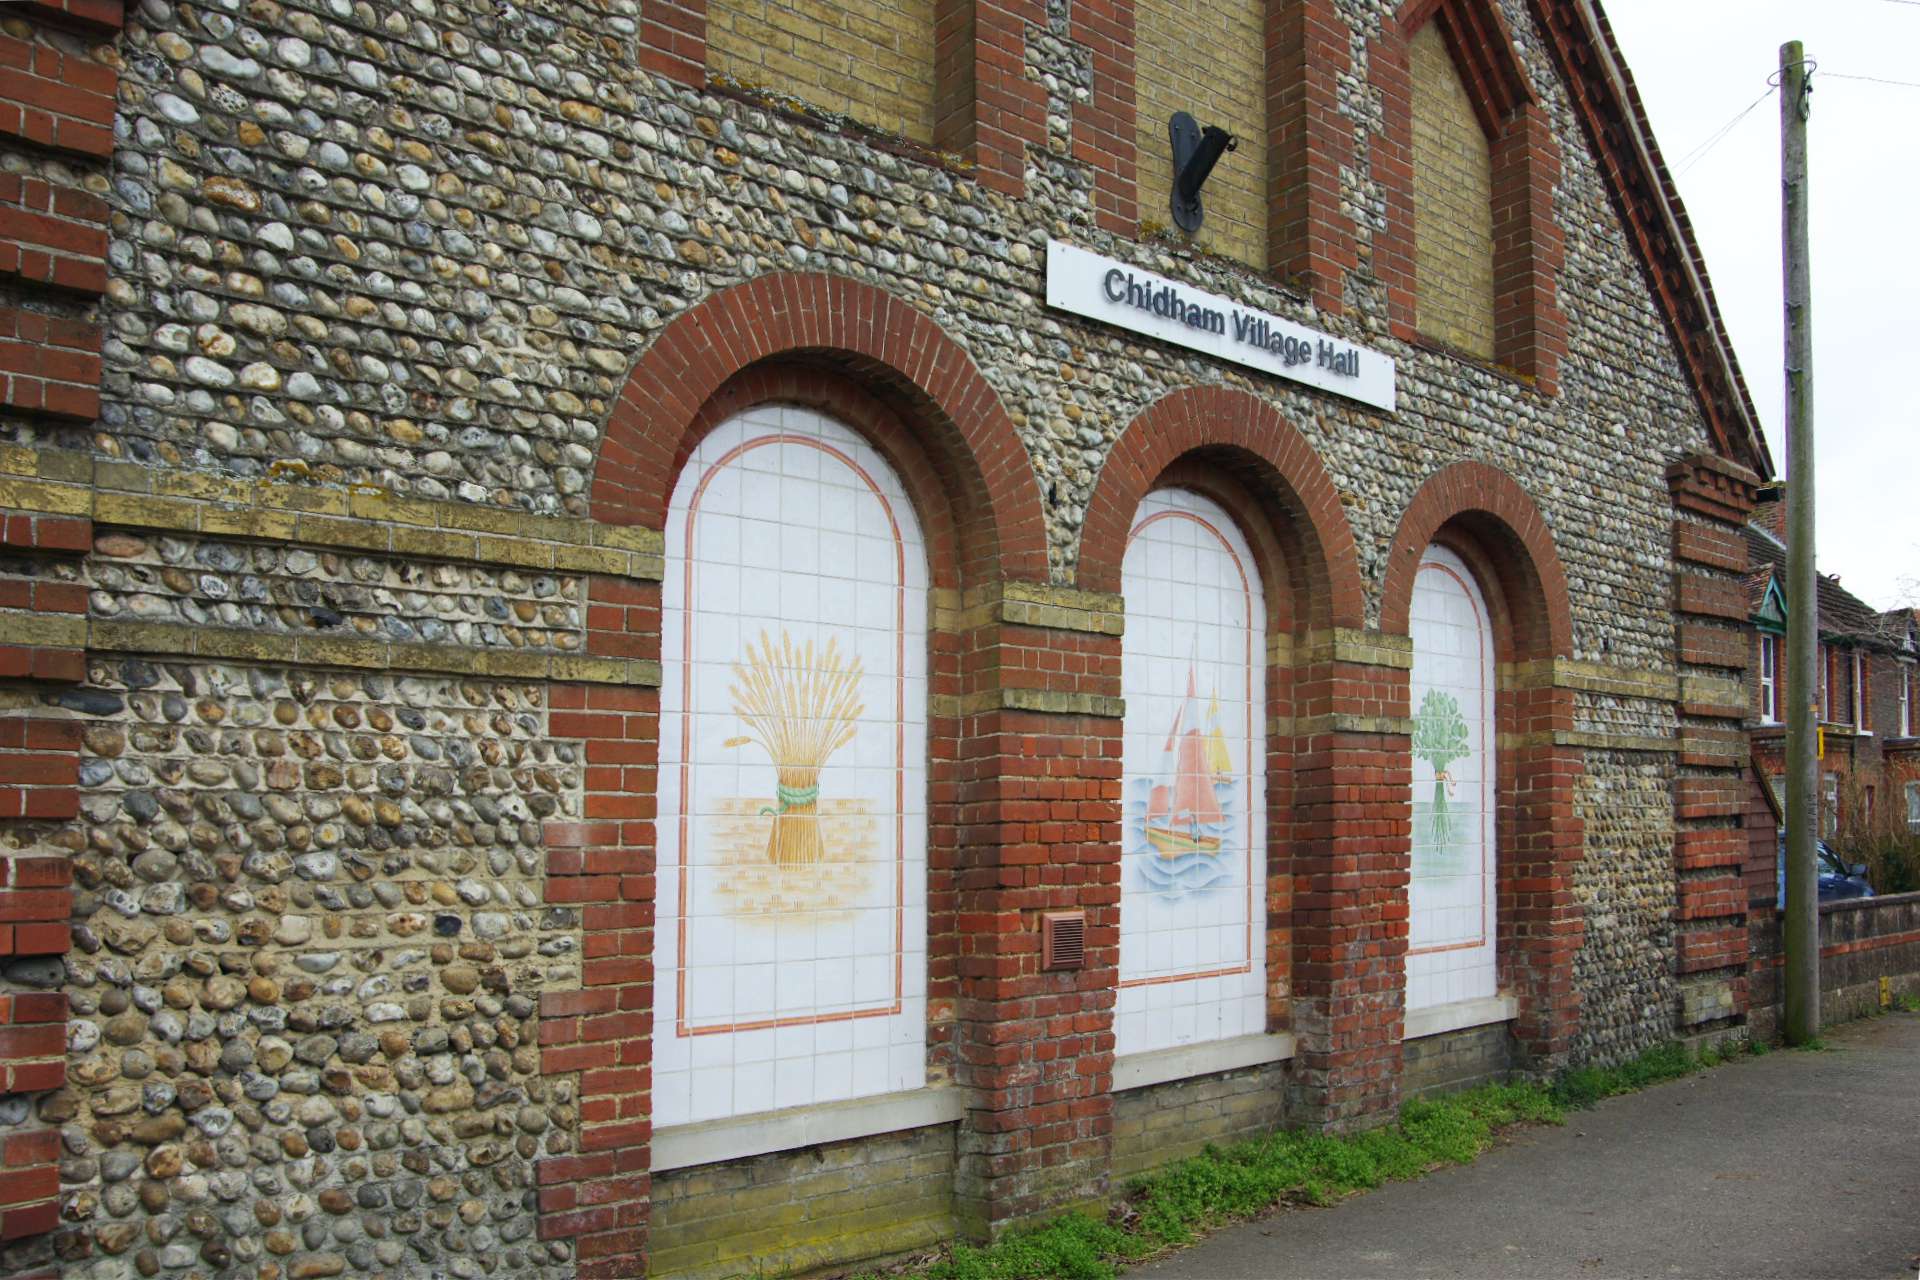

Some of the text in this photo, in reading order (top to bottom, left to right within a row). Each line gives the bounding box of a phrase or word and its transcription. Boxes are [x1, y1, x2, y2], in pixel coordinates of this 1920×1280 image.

[1105, 268, 1359, 378] Chidham Village Hall
